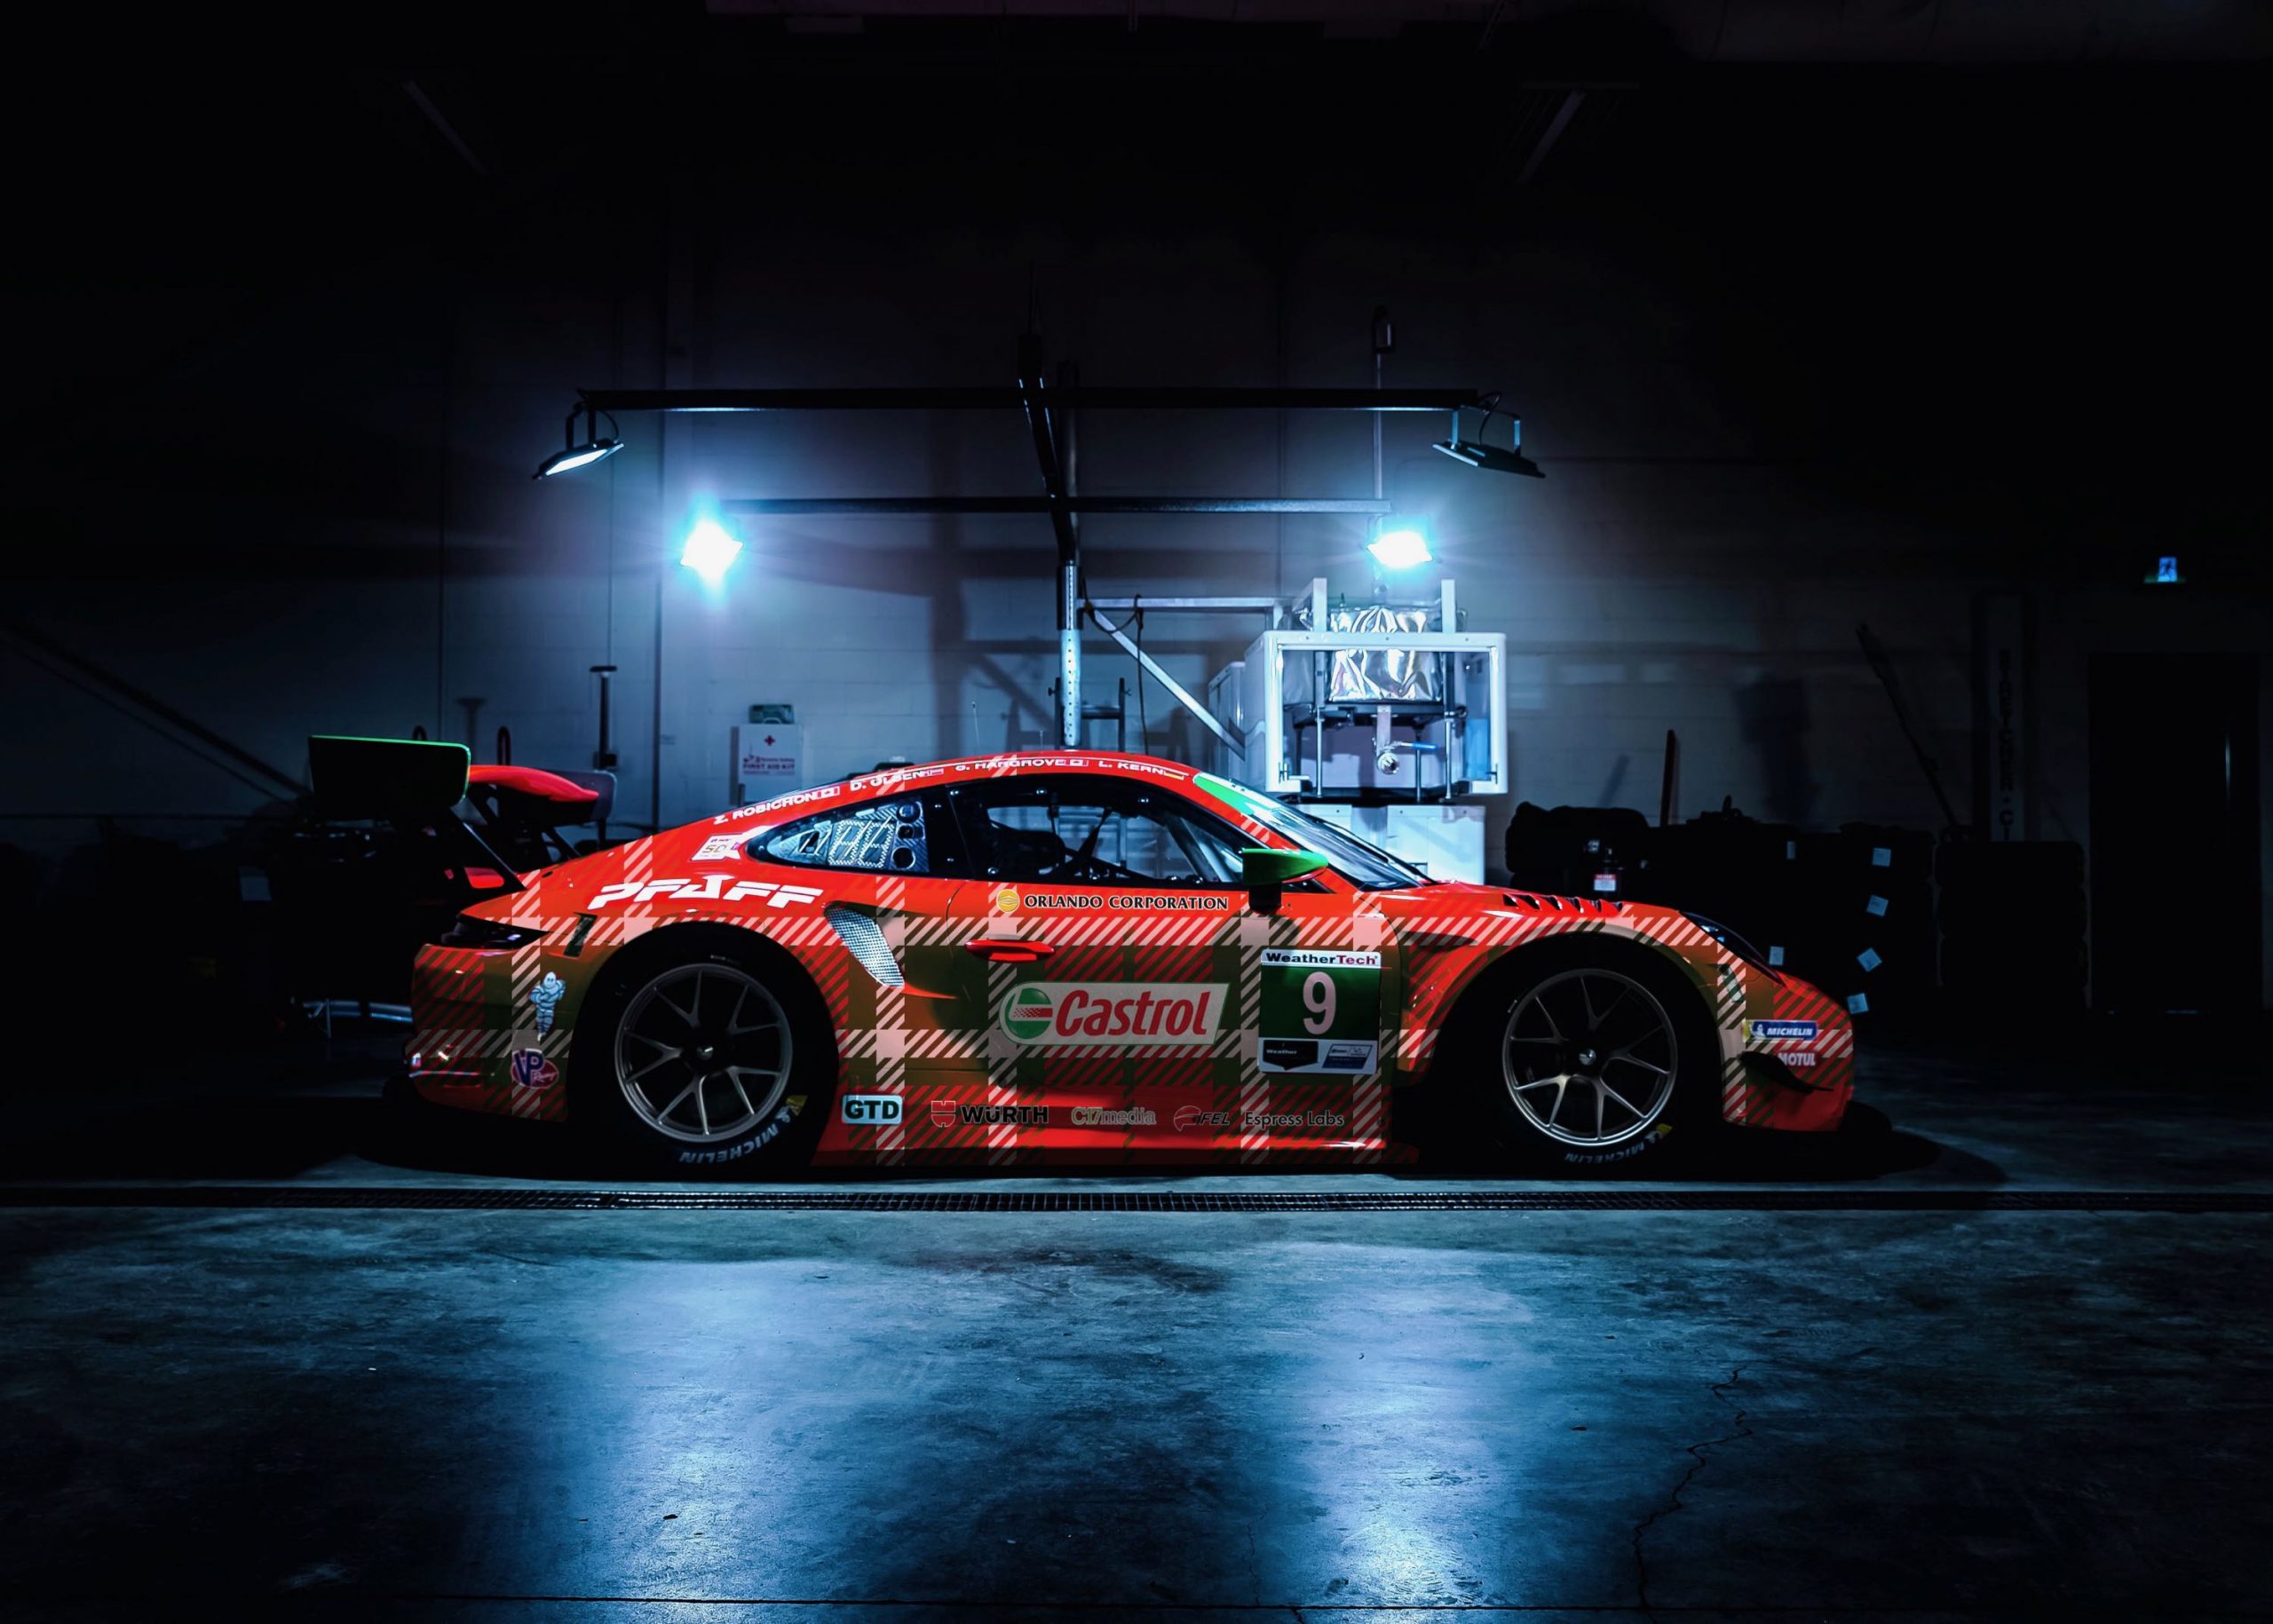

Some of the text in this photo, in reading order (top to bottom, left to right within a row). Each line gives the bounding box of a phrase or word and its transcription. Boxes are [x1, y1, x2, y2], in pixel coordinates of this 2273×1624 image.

[733, 794, 818, 820] ROBICHON
[870, 771, 923, 787] OLSEN
[975, 758, 1065, 770] HARGROVE
[1117, 763, 1164, 776] KERN
[587, 875, 824, 910] PFAFF
[1025, 894, 1229, 911] ORLANDO CORPORATION
[1266, 953, 1376, 966] WeatherTech
[1055, 989, 1211, 1036] Castrol
[1303, 971, 1336, 1035] 9
[1766, 1027, 1813, 1036] MICHELIN
[844, 1100, 899, 1120] GTD
[1245, 1110, 1345, 1130] Espress Labs
[679, 1123, 779, 1164] MICHELIN
[1564, 1142, 1645, 1163] MICHELIN
